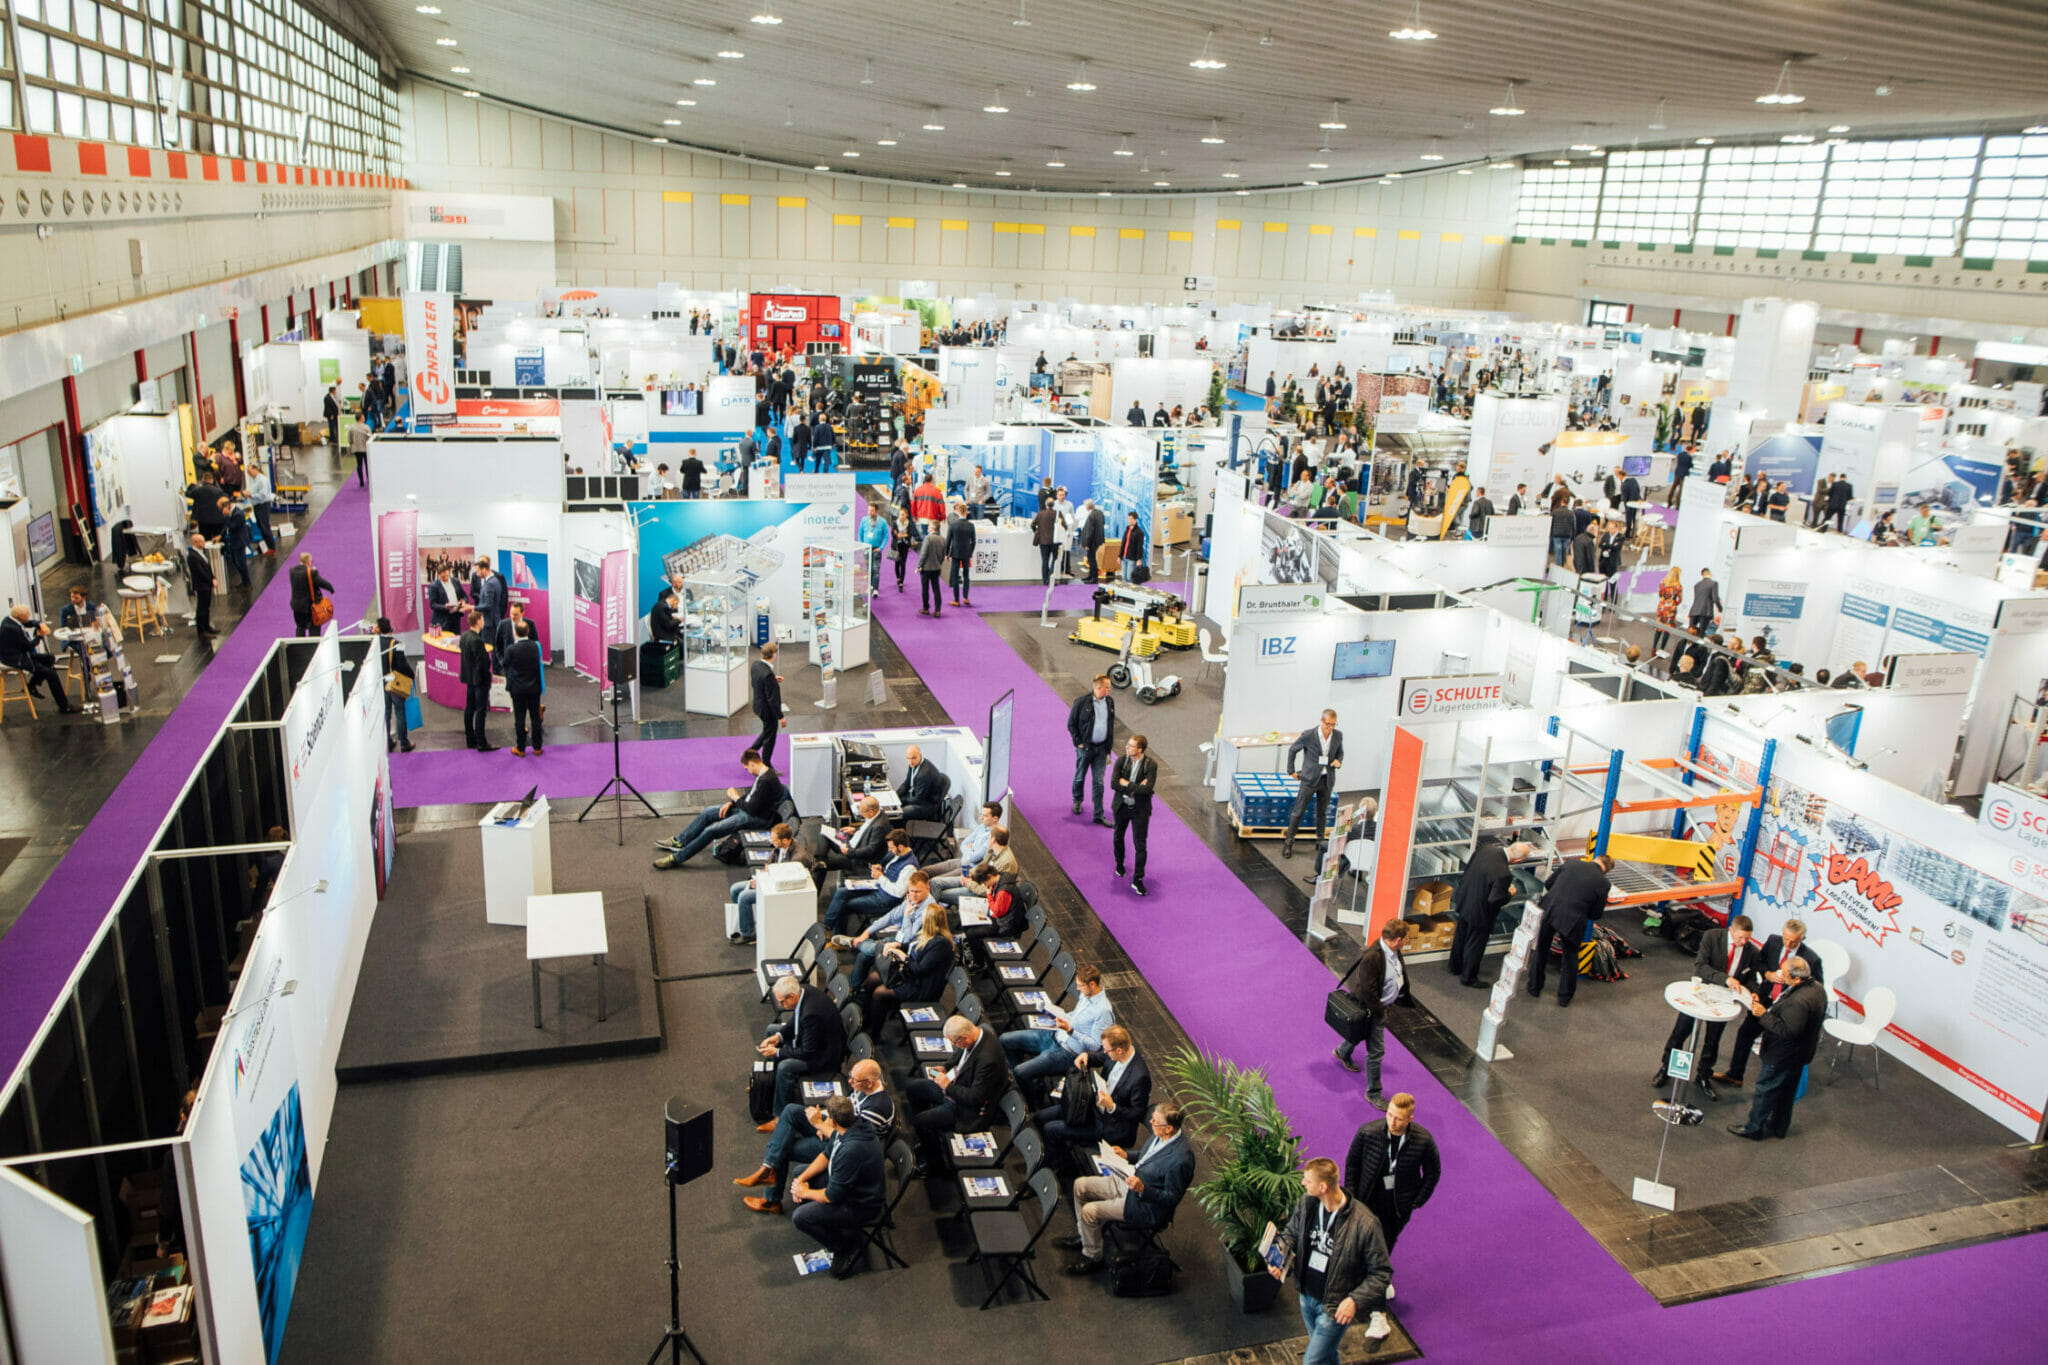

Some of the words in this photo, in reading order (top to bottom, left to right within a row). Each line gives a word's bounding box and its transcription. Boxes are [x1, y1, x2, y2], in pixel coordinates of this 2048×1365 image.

[804, 512, 840, 524] inotec
[1247, 601, 1257, 609] Dr.
[1262, 636, 1296, 656] IBZ
[1435, 686, 1501, 702] SCHULTE
[1433, 701, 1497, 714] Lagertechnik
[1828, 853, 1903, 912] BAM!
